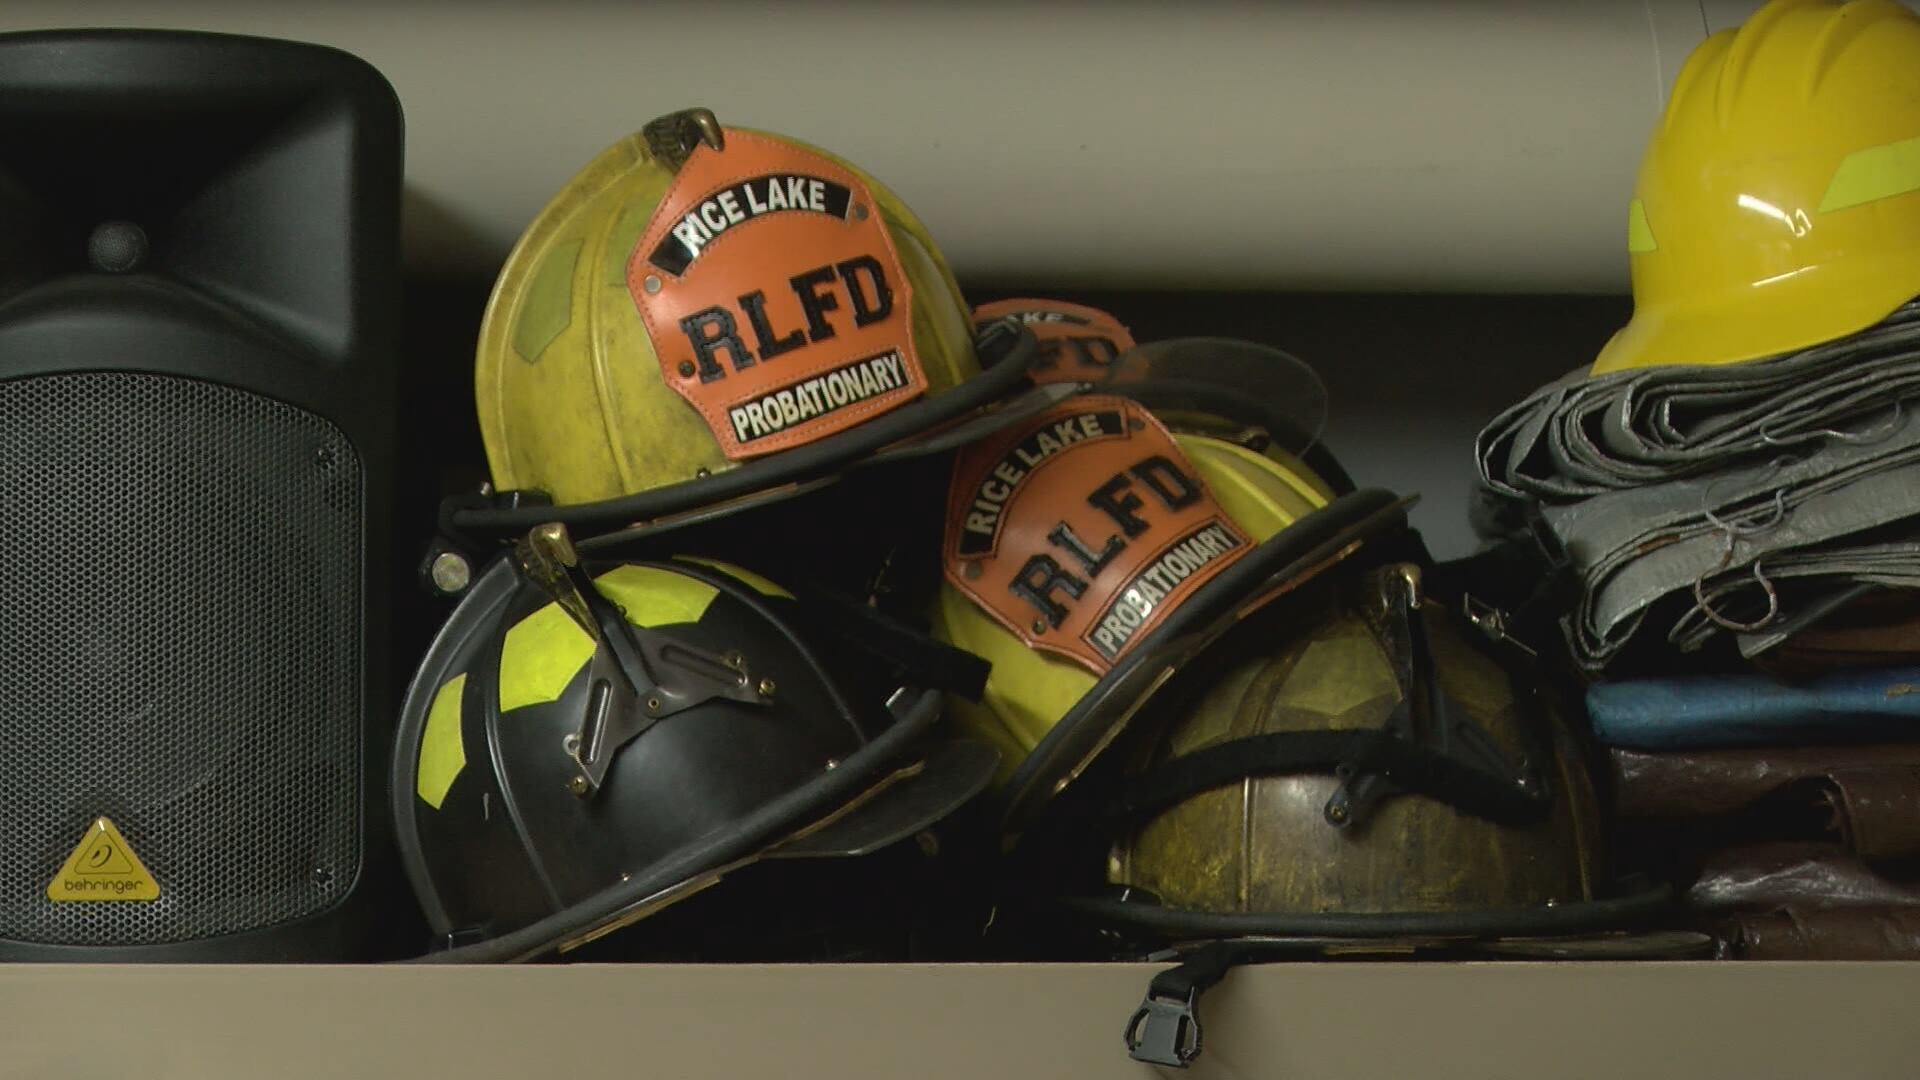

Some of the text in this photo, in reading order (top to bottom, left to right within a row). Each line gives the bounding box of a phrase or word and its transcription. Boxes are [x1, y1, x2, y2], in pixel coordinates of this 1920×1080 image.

[673, 176, 826, 258] RICE LAKE
[678, 254, 894, 384] RLFD
[731, 355, 902, 442] PROBATIONARY
[966, 413, 1102, 536] RICE LAKE
[1008, 455, 1204, 630] RLFD
[1095, 521, 1234, 653] PROBATIONARY
[64, 879, 144, 894] behringer
